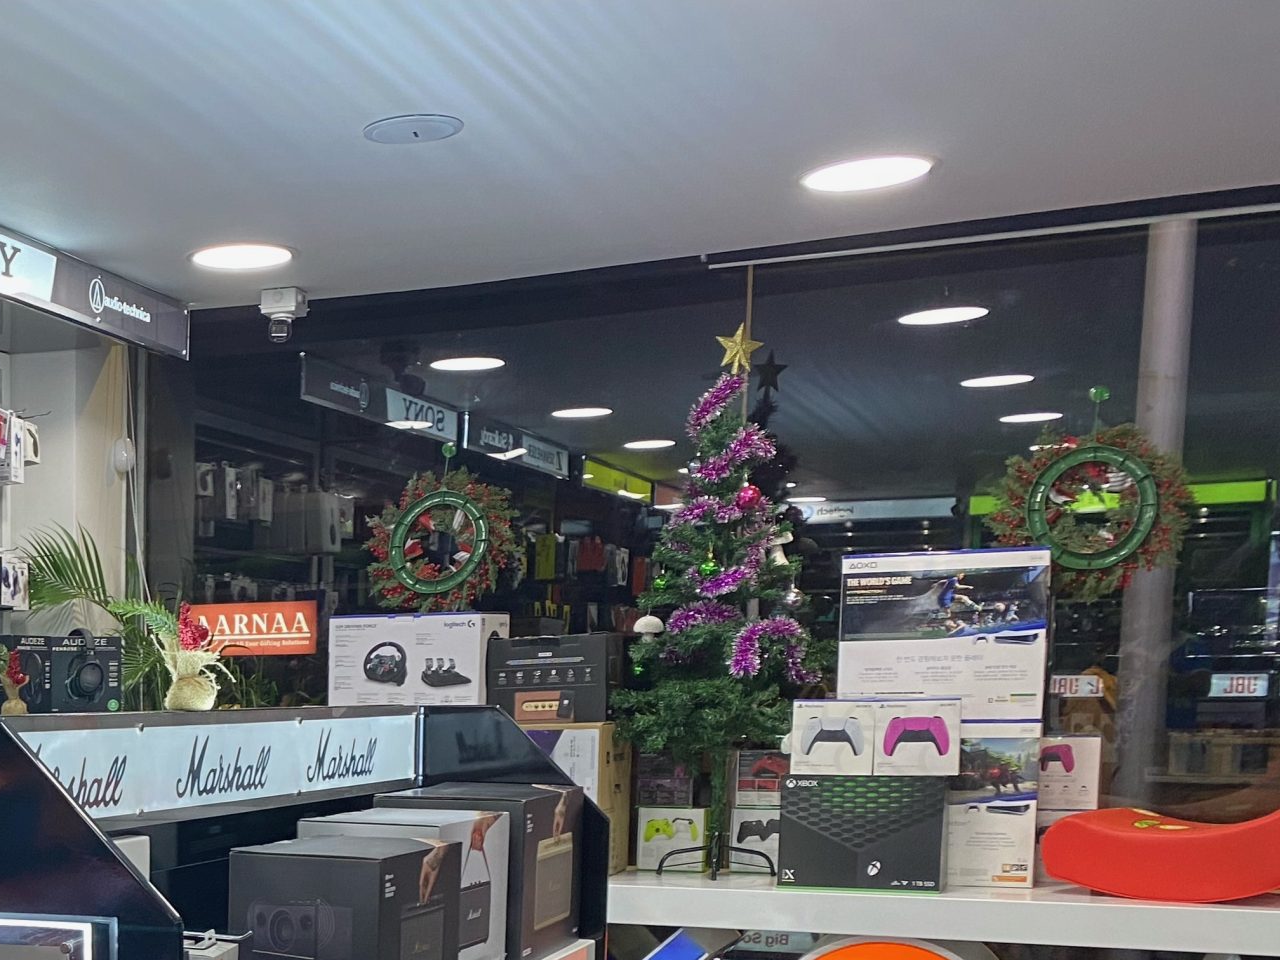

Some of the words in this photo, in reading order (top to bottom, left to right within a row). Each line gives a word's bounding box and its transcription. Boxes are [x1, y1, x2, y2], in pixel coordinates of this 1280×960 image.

[103, 294, 151, 323] audio-technica
[891, 575, 913, 585] GAME
[20, 637, 45, 645] AUDEZE
[62, 638, 108, 646] AUDZE
[307, 728, 378, 783] Marshall
[176, 735, 272, 799] Marshall
